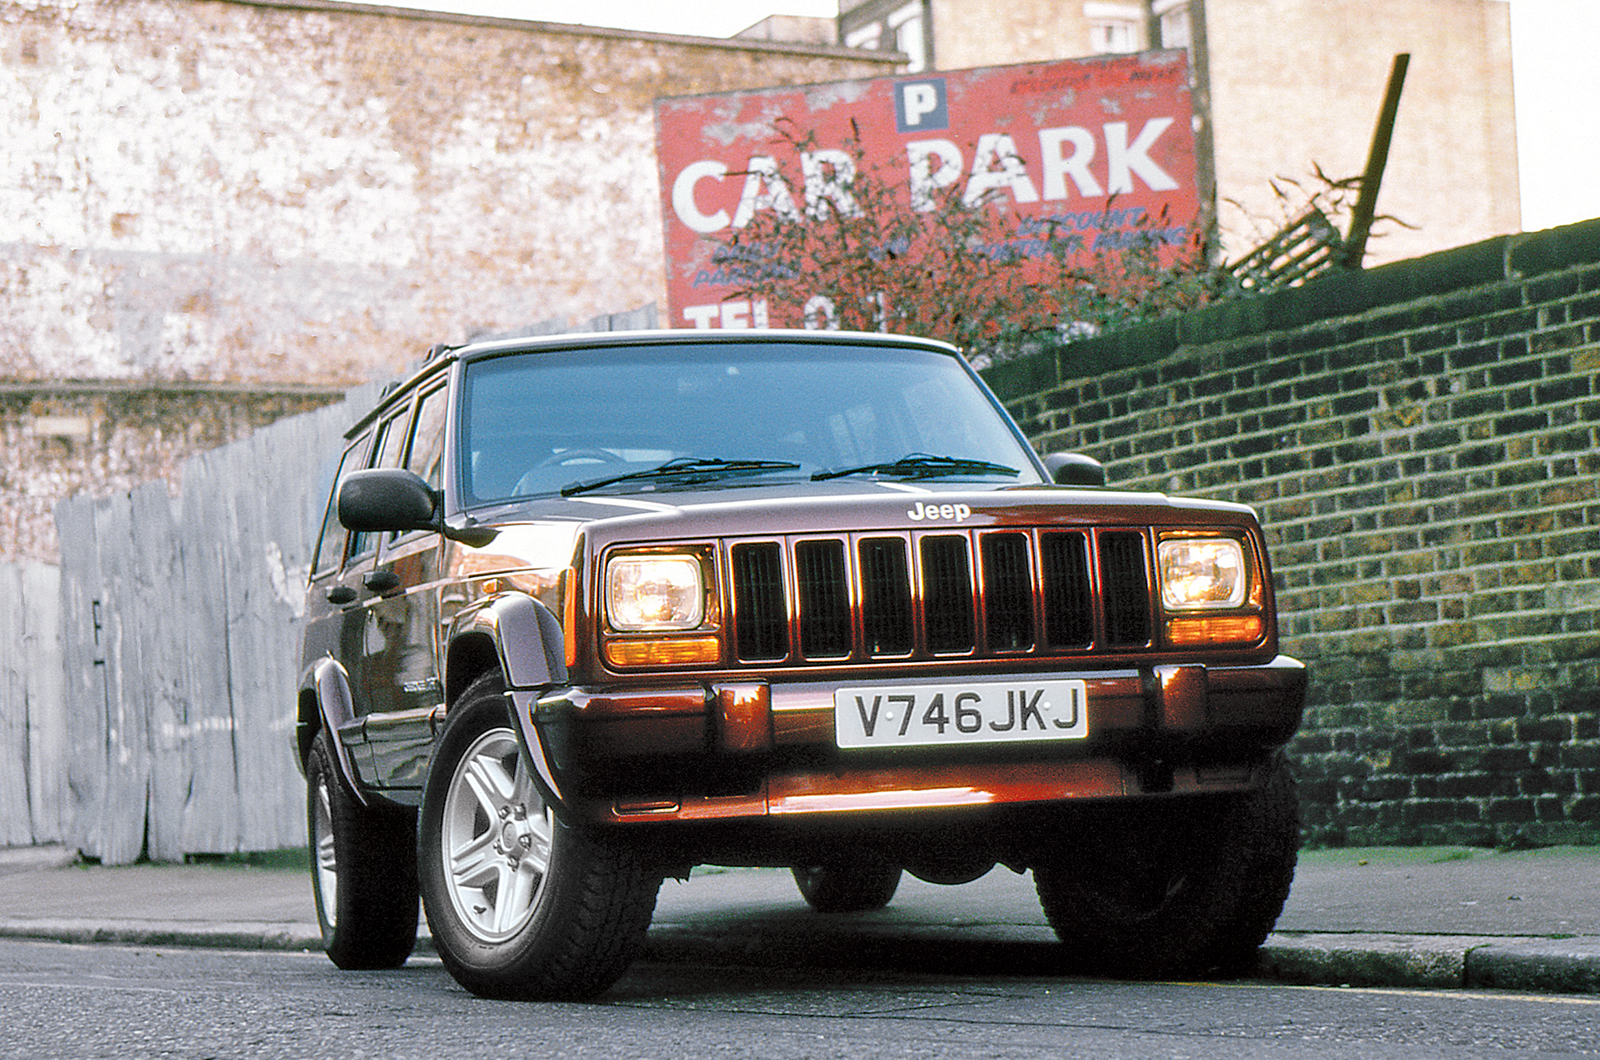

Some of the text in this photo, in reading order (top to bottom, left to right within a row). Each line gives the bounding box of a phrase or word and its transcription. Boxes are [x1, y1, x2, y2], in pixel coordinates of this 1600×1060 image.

[903, 83, 937, 125] P
[672, 117, 1180, 234] CAR PARK
[907, 502, 971, 522] Jeep
